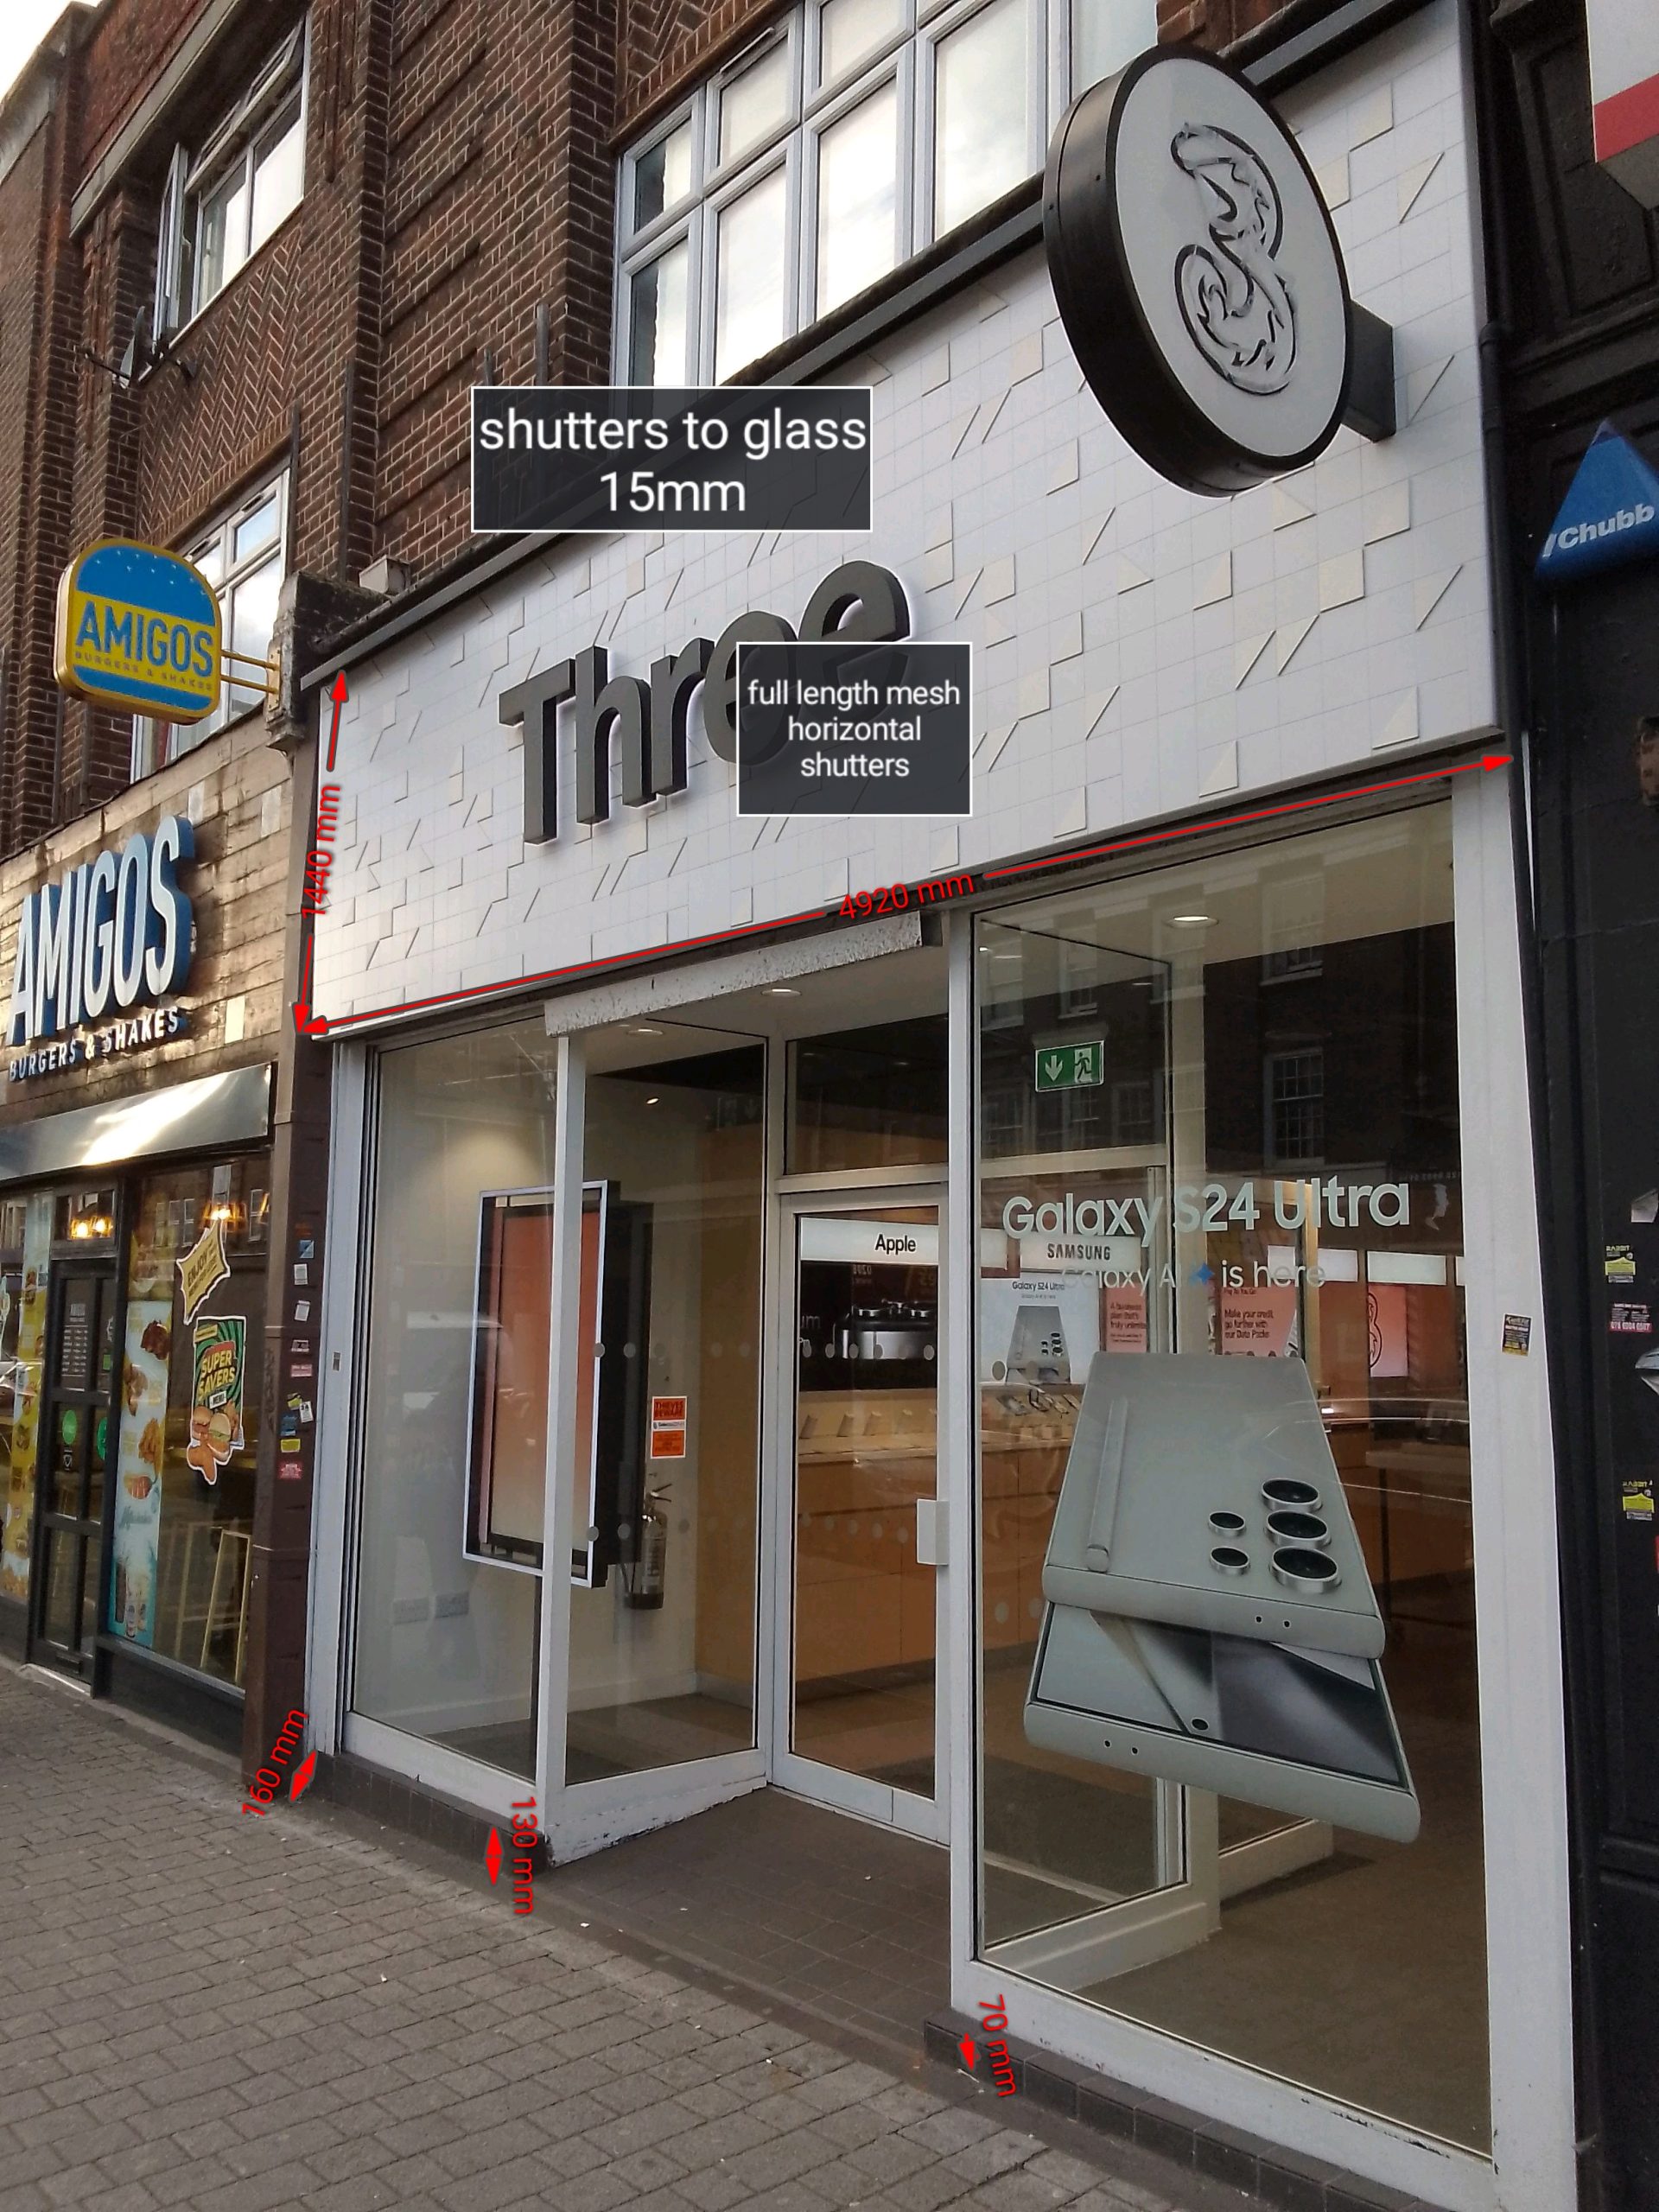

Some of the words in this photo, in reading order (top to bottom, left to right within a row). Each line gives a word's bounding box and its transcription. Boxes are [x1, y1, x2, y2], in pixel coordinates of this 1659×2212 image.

[1558, 503, 1656, 550] Chubb
[75, 601, 213, 678] AMIGOS
[499, 560, 912, 846] Three
[6, 816, 192, 1046] AMIGOS
[9, 1039, 77, 1081] BURGERS
[86, 1034, 95, 1060] &
[102, 1006, 179, 1053] SHAKES
[1002, 1192, 1163, 1248] Galaxy
[1173, 1182, 1261, 1233] S24
[1274, 1175, 1409, 1230] Ultra
[875, 1234, 917, 1255] Apple
[1047, 1243, 1111, 1261] SAMSUNG
[1012, 1281, 1037, 1291] Galaxy
[1061, 1267, 1151, 1297] Galaxy
[1221, 1260, 1243, 1287] is
[1254, 1260, 1325, 1287] here
[197, 1366, 236, 1402] SAVERS
[201, 1349, 232, 1379] SUPER
